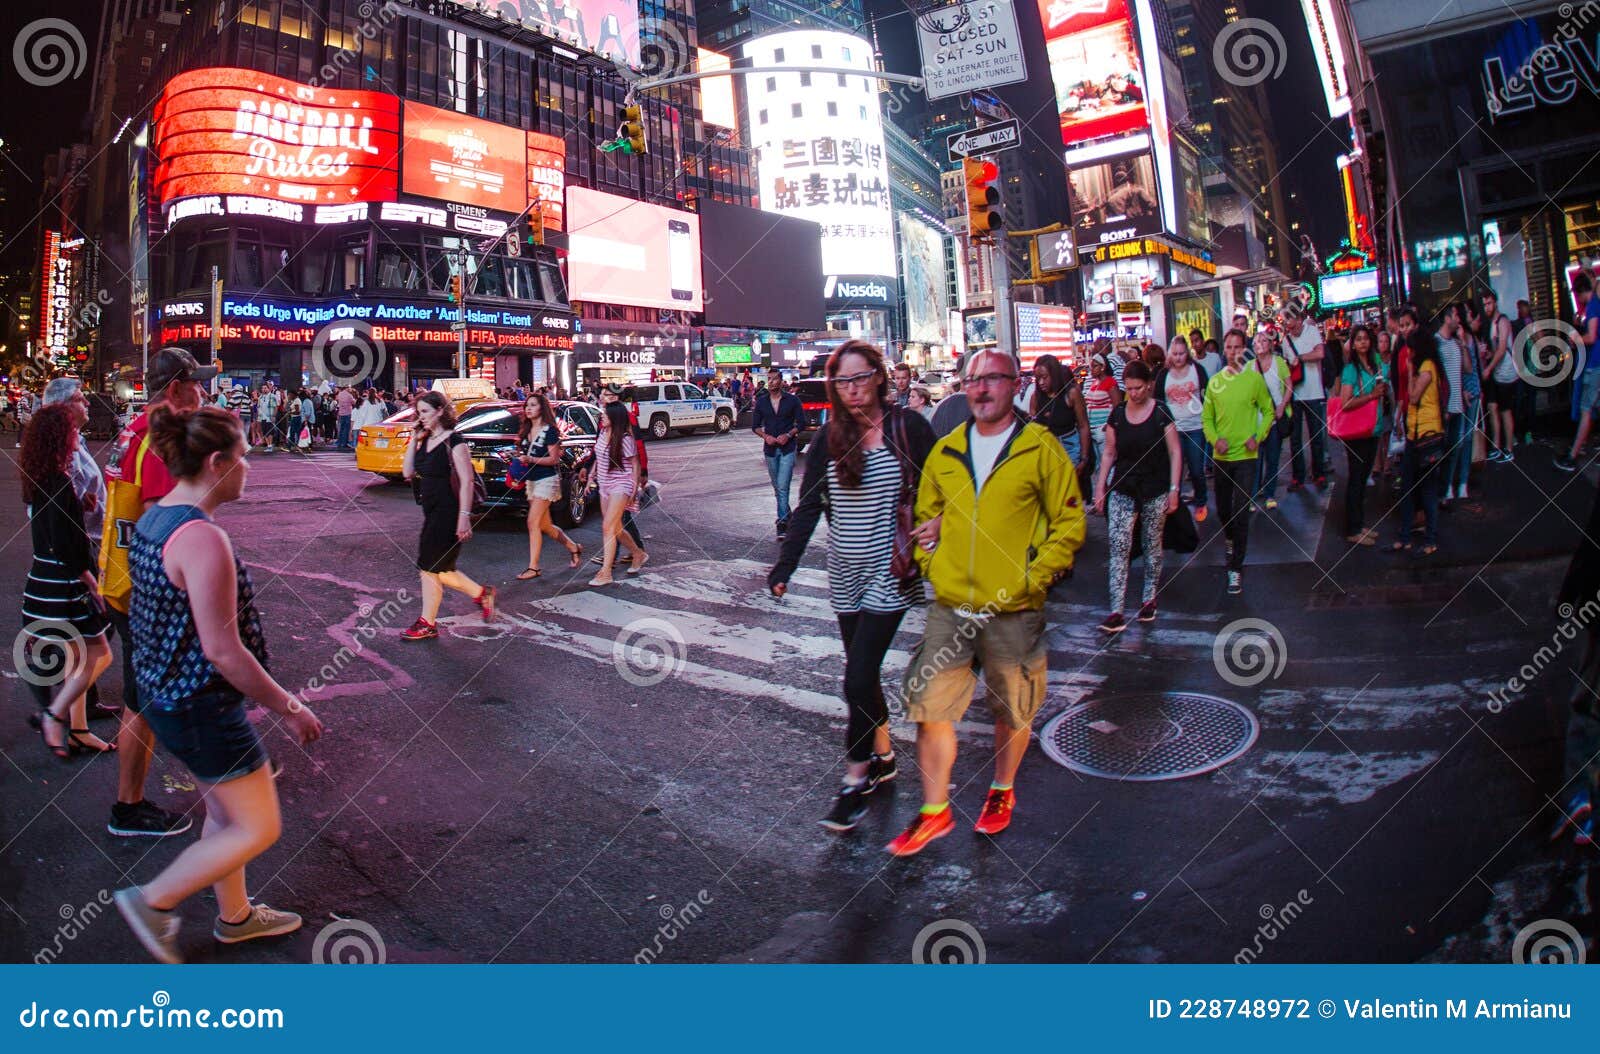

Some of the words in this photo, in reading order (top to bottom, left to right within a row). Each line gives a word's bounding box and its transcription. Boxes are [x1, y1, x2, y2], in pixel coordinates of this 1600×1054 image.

[979, 5, 996, 19] ST
[939, 23, 998, 46] CLOSED
[937, 38, 1007, 64] SAT-SUN
[947, 61, 992, 76] ALTERNATE
[994, 53, 1019, 65] ROUTE
[934, 81, 944, 89] TO
[947, 73, 981, 87] LINCOLN
[984, 66, 1017, 79] TUNNEL
[233, 100, 379, 155] BASEBALL
[957, 137, 979, 152] ONE
[989, 129, 1012, 143] WAY
[245, 138, 351, 178] Rules
[447, 203, 488, 218] SIEMENS
[1100, 228, 1136, 242] SONY
[838, 282, 887, 301] Nasdaq
[172, 302, 204, 316] NEWS
[224, 302, 260, 318] Feds
[263, 303, 292, 322] Urge
[336, 303, 373, 318] Over
[375, 304, 432, 320] Another
[435, 307, 500, 324] 'Ant-Islam'
[503, 312, 532, 327] Event
[180, 325, 192, 338] in
[246, 324, 276, 339] 'You
[279, 328, 315, 342] can't'
[371, 326, 421, 341] Blatter
[471, 329, 497, 344] FIFA
[498, 333, 544, 347] president
[545, 335, 557, 348] for
[598, 350, 655, 363] SEPHOR
[693, 402, 712, 410] NYPD
